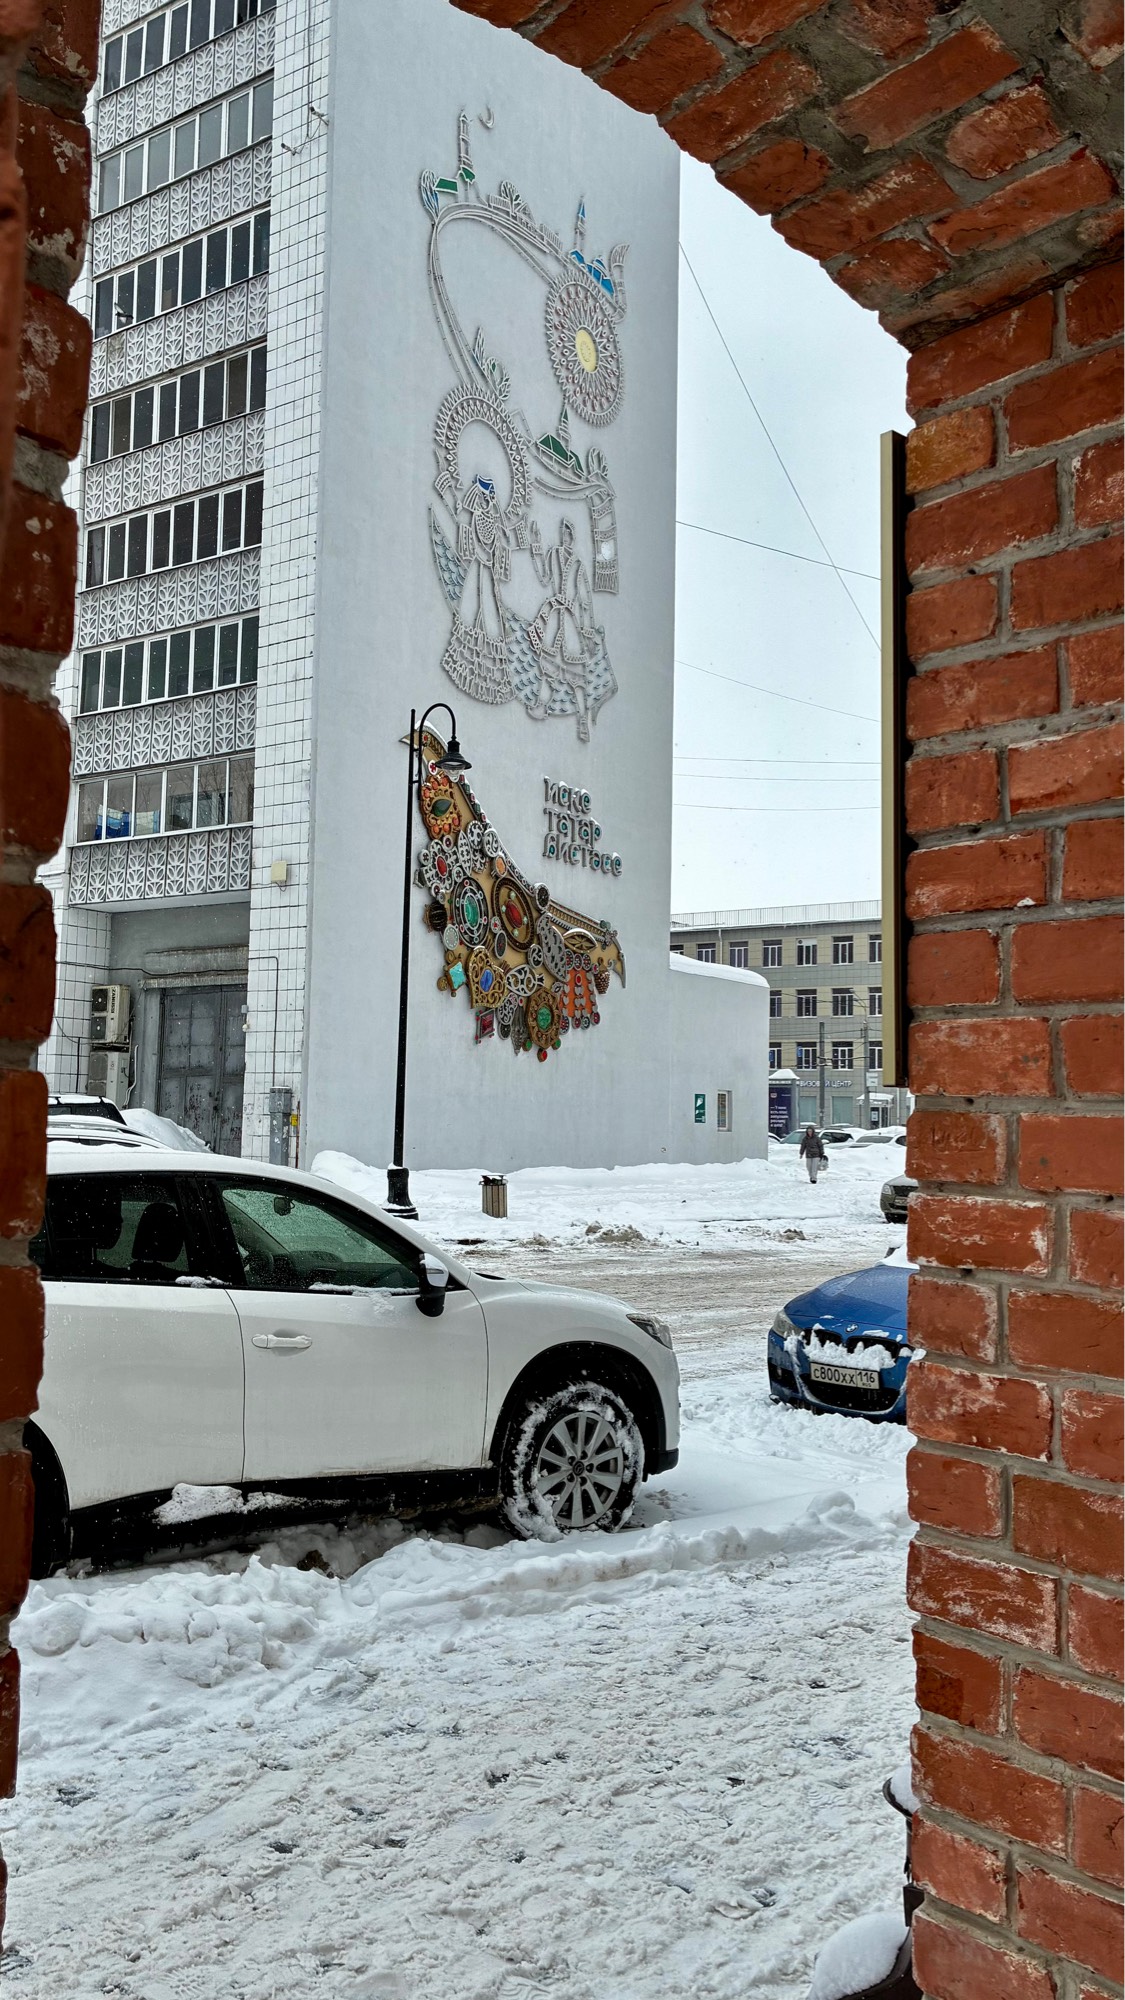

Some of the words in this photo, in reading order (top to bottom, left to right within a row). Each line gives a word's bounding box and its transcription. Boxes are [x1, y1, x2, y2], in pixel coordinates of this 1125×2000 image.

[799, 1080, 830, 1088] ВИЗОВЙ
[831, 1080, 853, 1089] ЦЕНТР
[857, 1371, 876, 1383] 116
